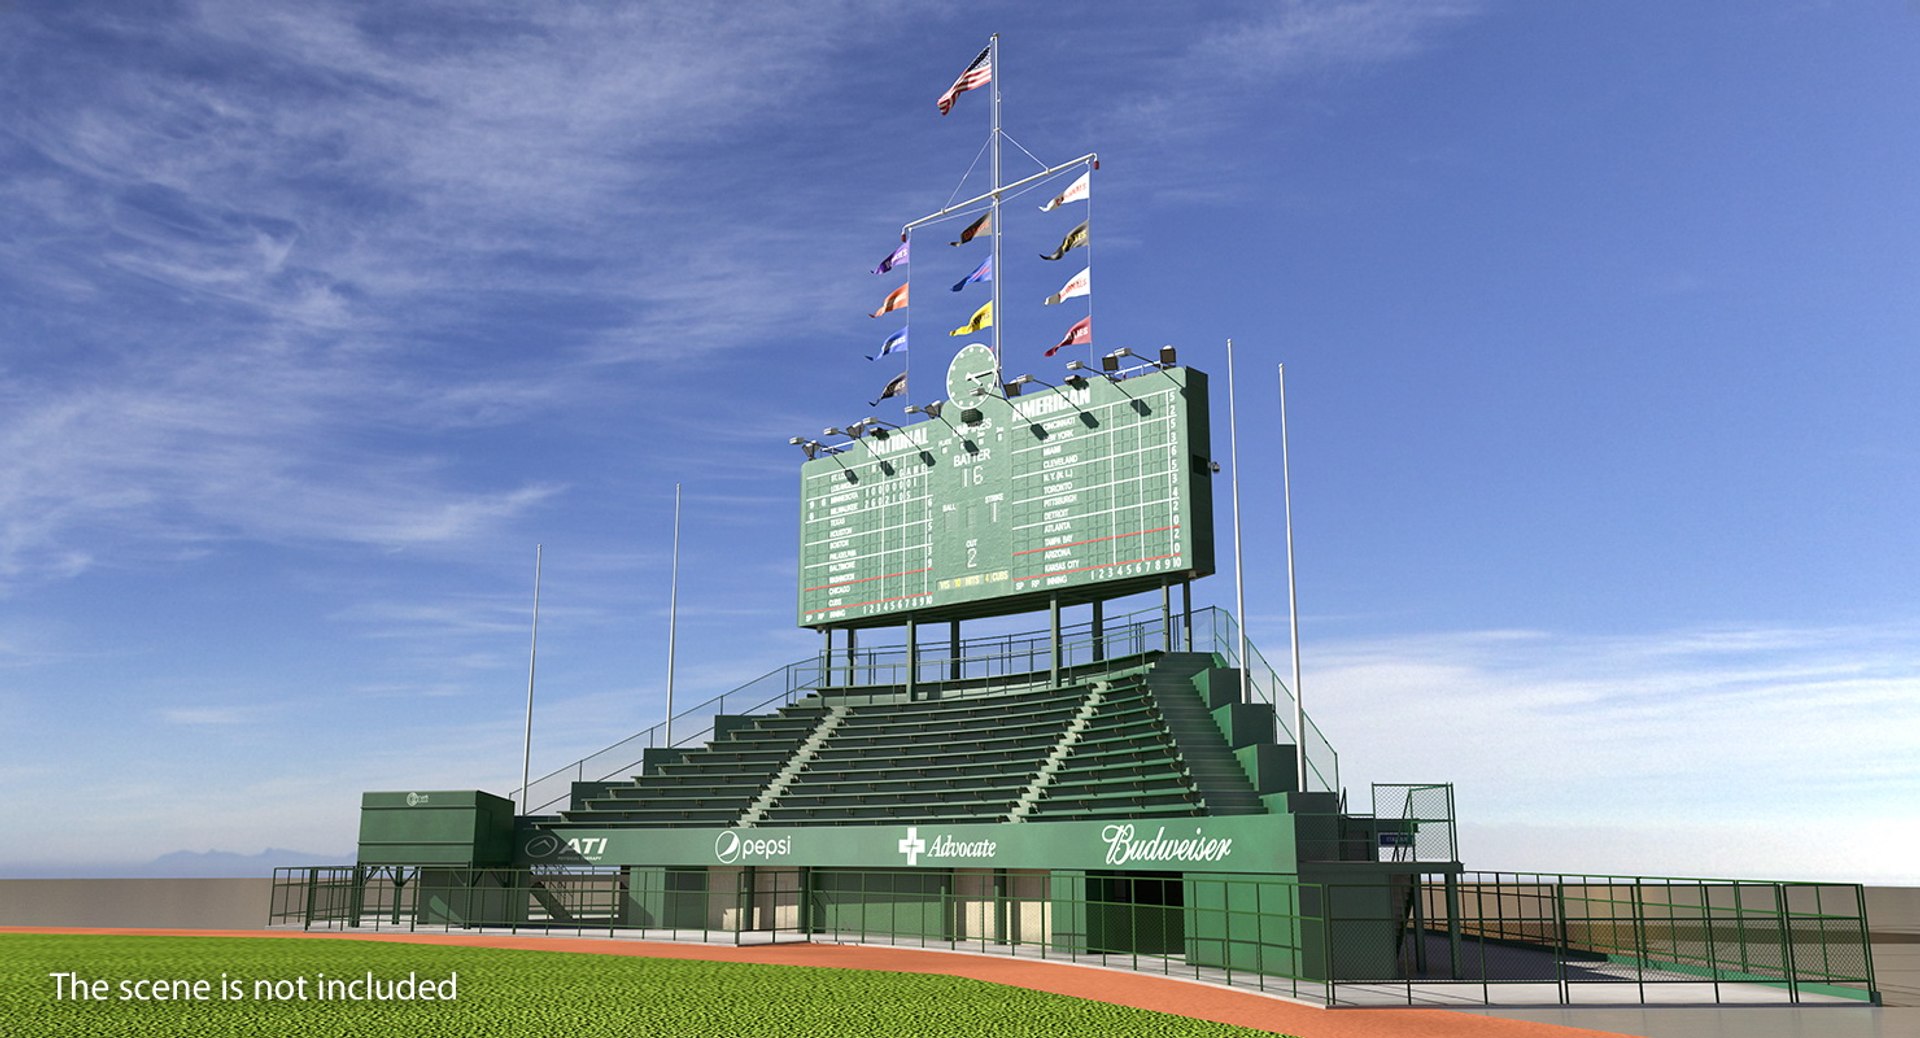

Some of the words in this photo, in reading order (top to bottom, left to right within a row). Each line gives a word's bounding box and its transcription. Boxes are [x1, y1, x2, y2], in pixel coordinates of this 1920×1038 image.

[1012, 387, 1090, 422] AMERICAN
[952, 417, 992, 436] UMES
[868, 427, 928, 458] NATIONAL
[964, 465, 983, 487] 16
[967, 548, 977, 568] 2
[559, 838, 608, 854] ATI
[742, 835, 791, 859] pepsi
[927, 835, 997, 858] Advocate
[1102, 824, 1233, 866] Budweiser
